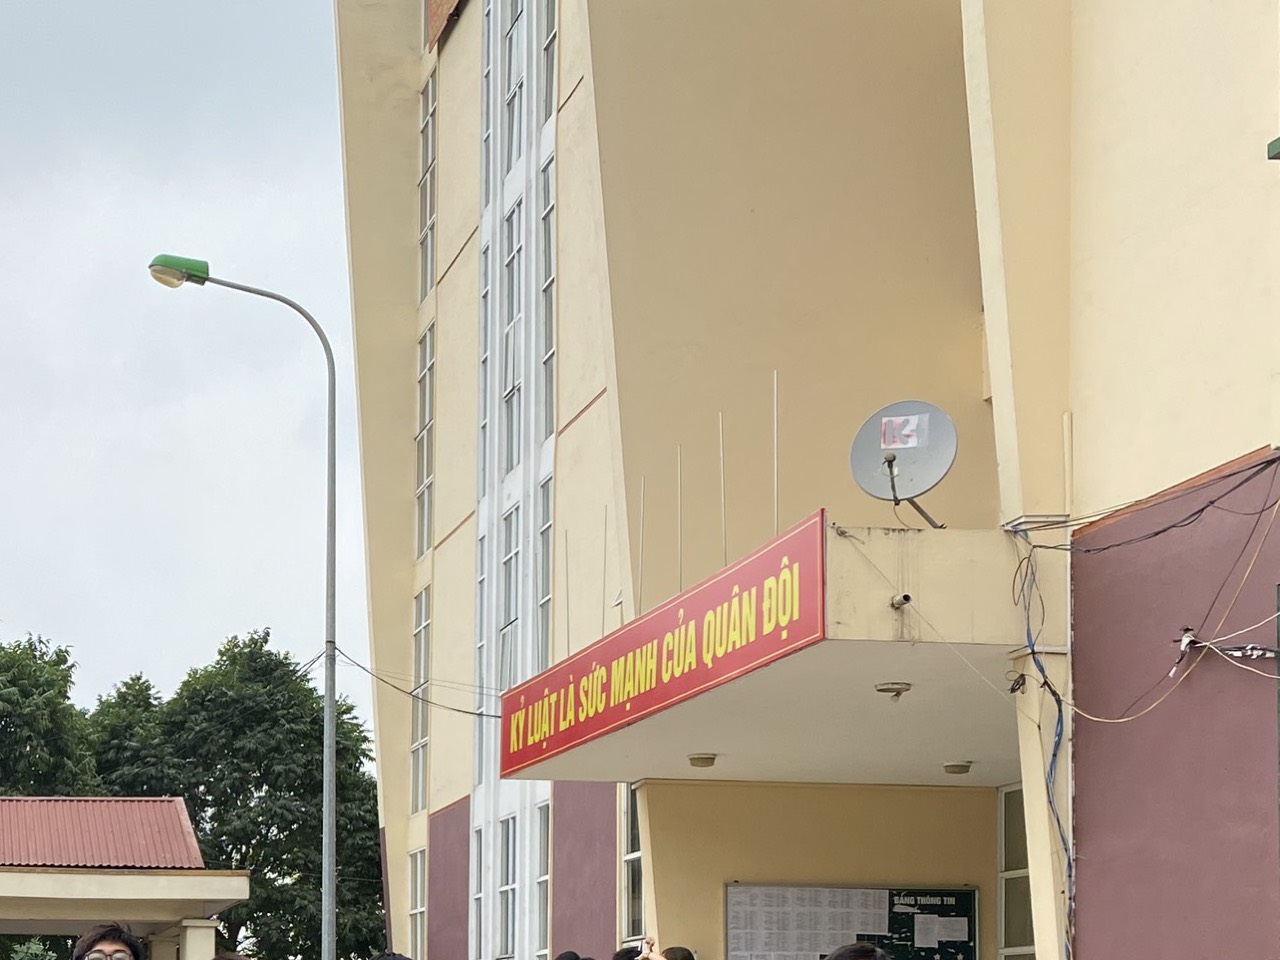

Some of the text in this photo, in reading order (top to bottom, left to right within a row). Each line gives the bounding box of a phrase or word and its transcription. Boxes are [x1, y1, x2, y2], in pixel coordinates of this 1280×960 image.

[527, 688, 557, 749] LUẬT
[559, 674, 575, 732] LÀ
[578, 662, 607, 722] SỨC
[610, 640, 658, 710] MẠNH
[662, 609, 696, 683] CỦA
[703, 585, 757, 668] QUÂN
[763, 556, 800, 639] ĐỘI
